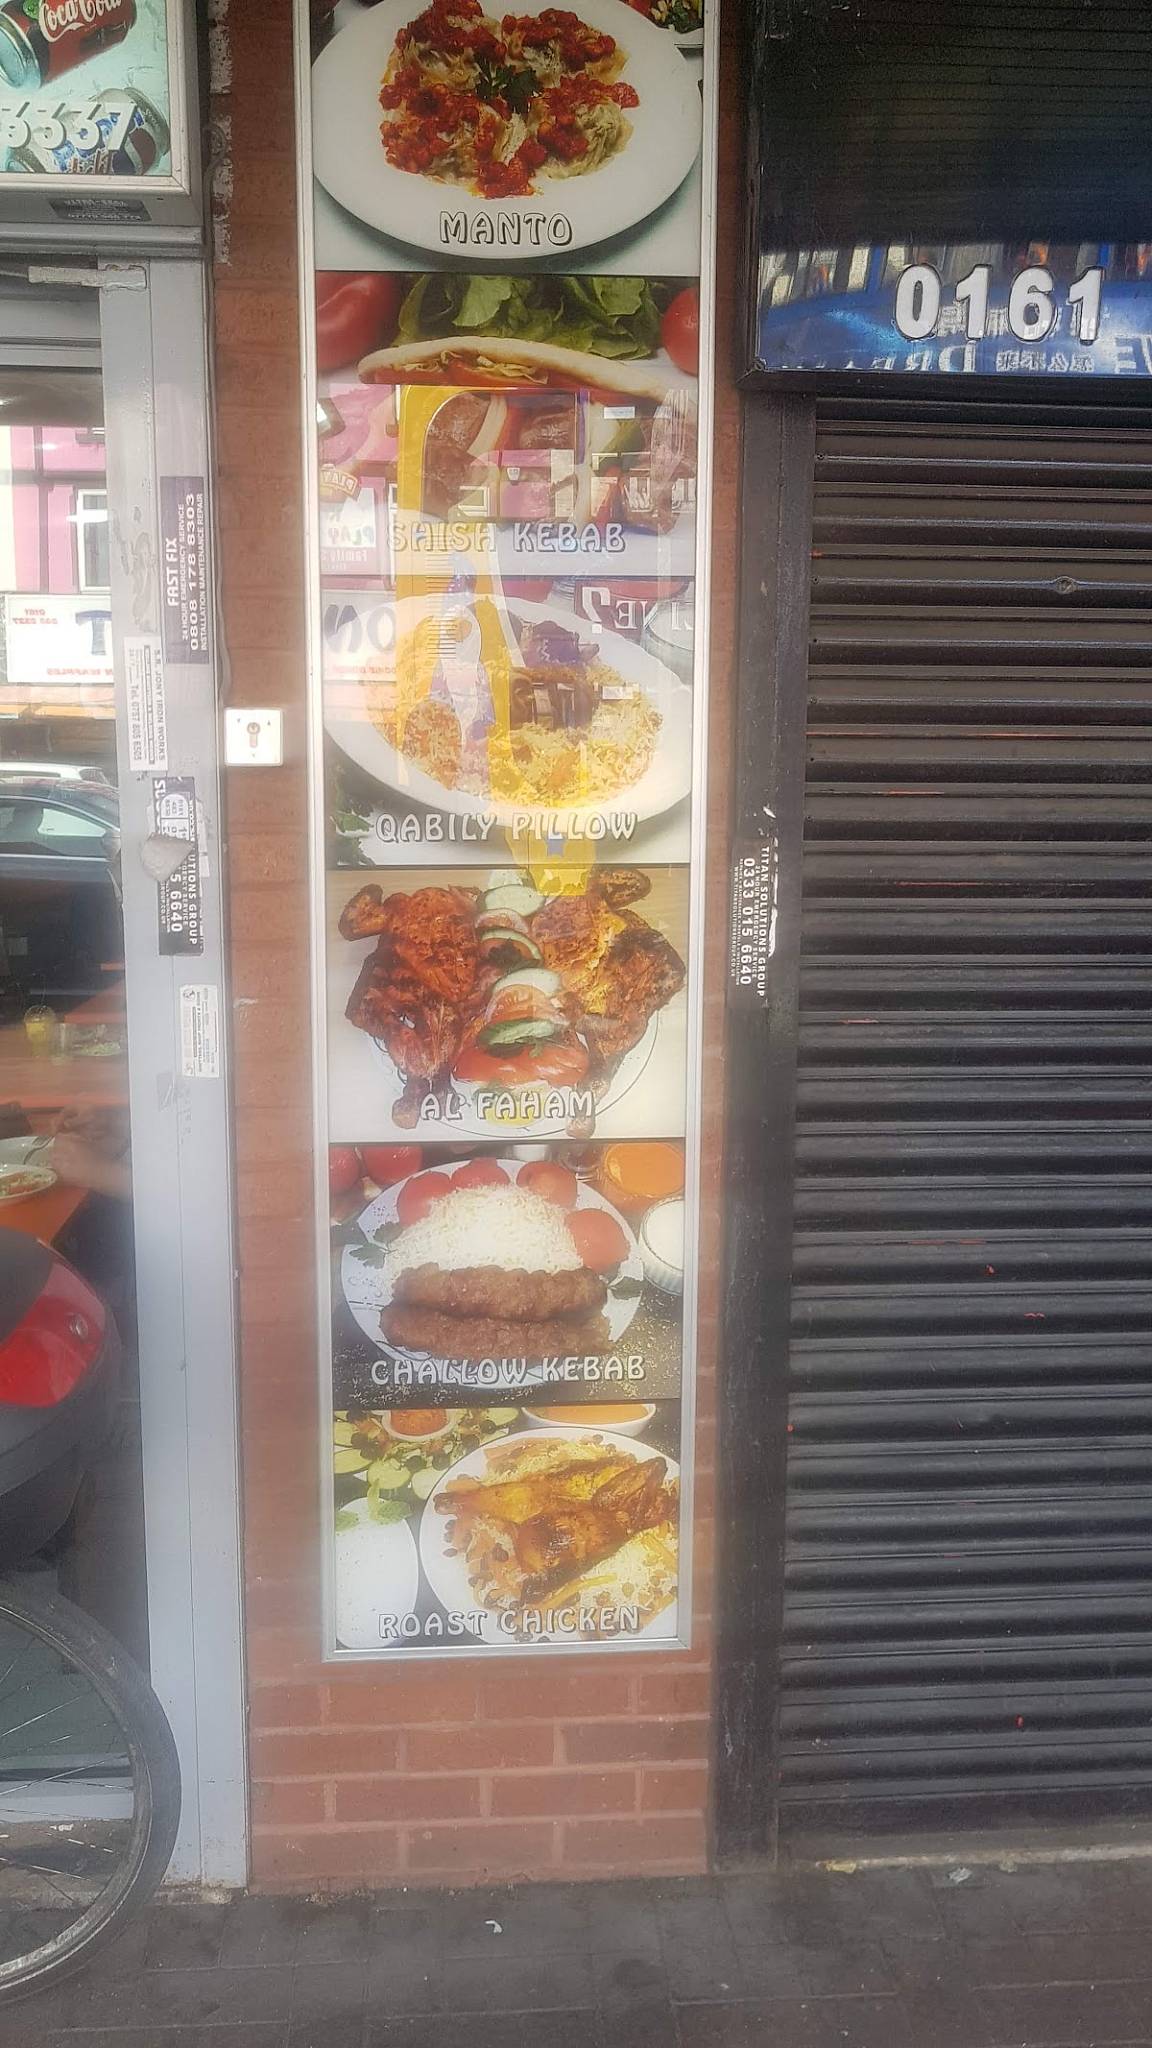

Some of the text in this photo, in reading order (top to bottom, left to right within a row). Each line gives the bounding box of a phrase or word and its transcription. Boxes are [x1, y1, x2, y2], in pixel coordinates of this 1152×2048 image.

[440, 211, 573, 246] MANTO
[895, 263, 1105, 345] 0161
[177, 503, 185, 543] SERVICE
[388, 521, 626, 553] SHISH KEBAB
[165, 537, 179, 607] FAST FIX
[178, 545, 187, 600] EMERGENCY
[186, 493, 199, 651] 0808 178 8303
[195, 492, 208, 651] INSTALLATION MAINTENANCE REPAIR
[156, 700, 164, 723] IRON
[157, 726, 165, 761] WORKS
[375, 811, 639, 844] QABILY PILLOW
[171, 890, 183, 933] 6640
[188, 853, 197, 945] UTIONS GROUP
[740, 857, 755, 985] 0333 015 6640
[756, 846, 770, 997] TITAN SOLUTIONS GROUP
[420, 1090, 595, 1121] AL FAHAM
[371, 1355, 646, 1385] CHALLOW KEBAB
[378, 1605, 640, 1639] ROAST CHICKEN
